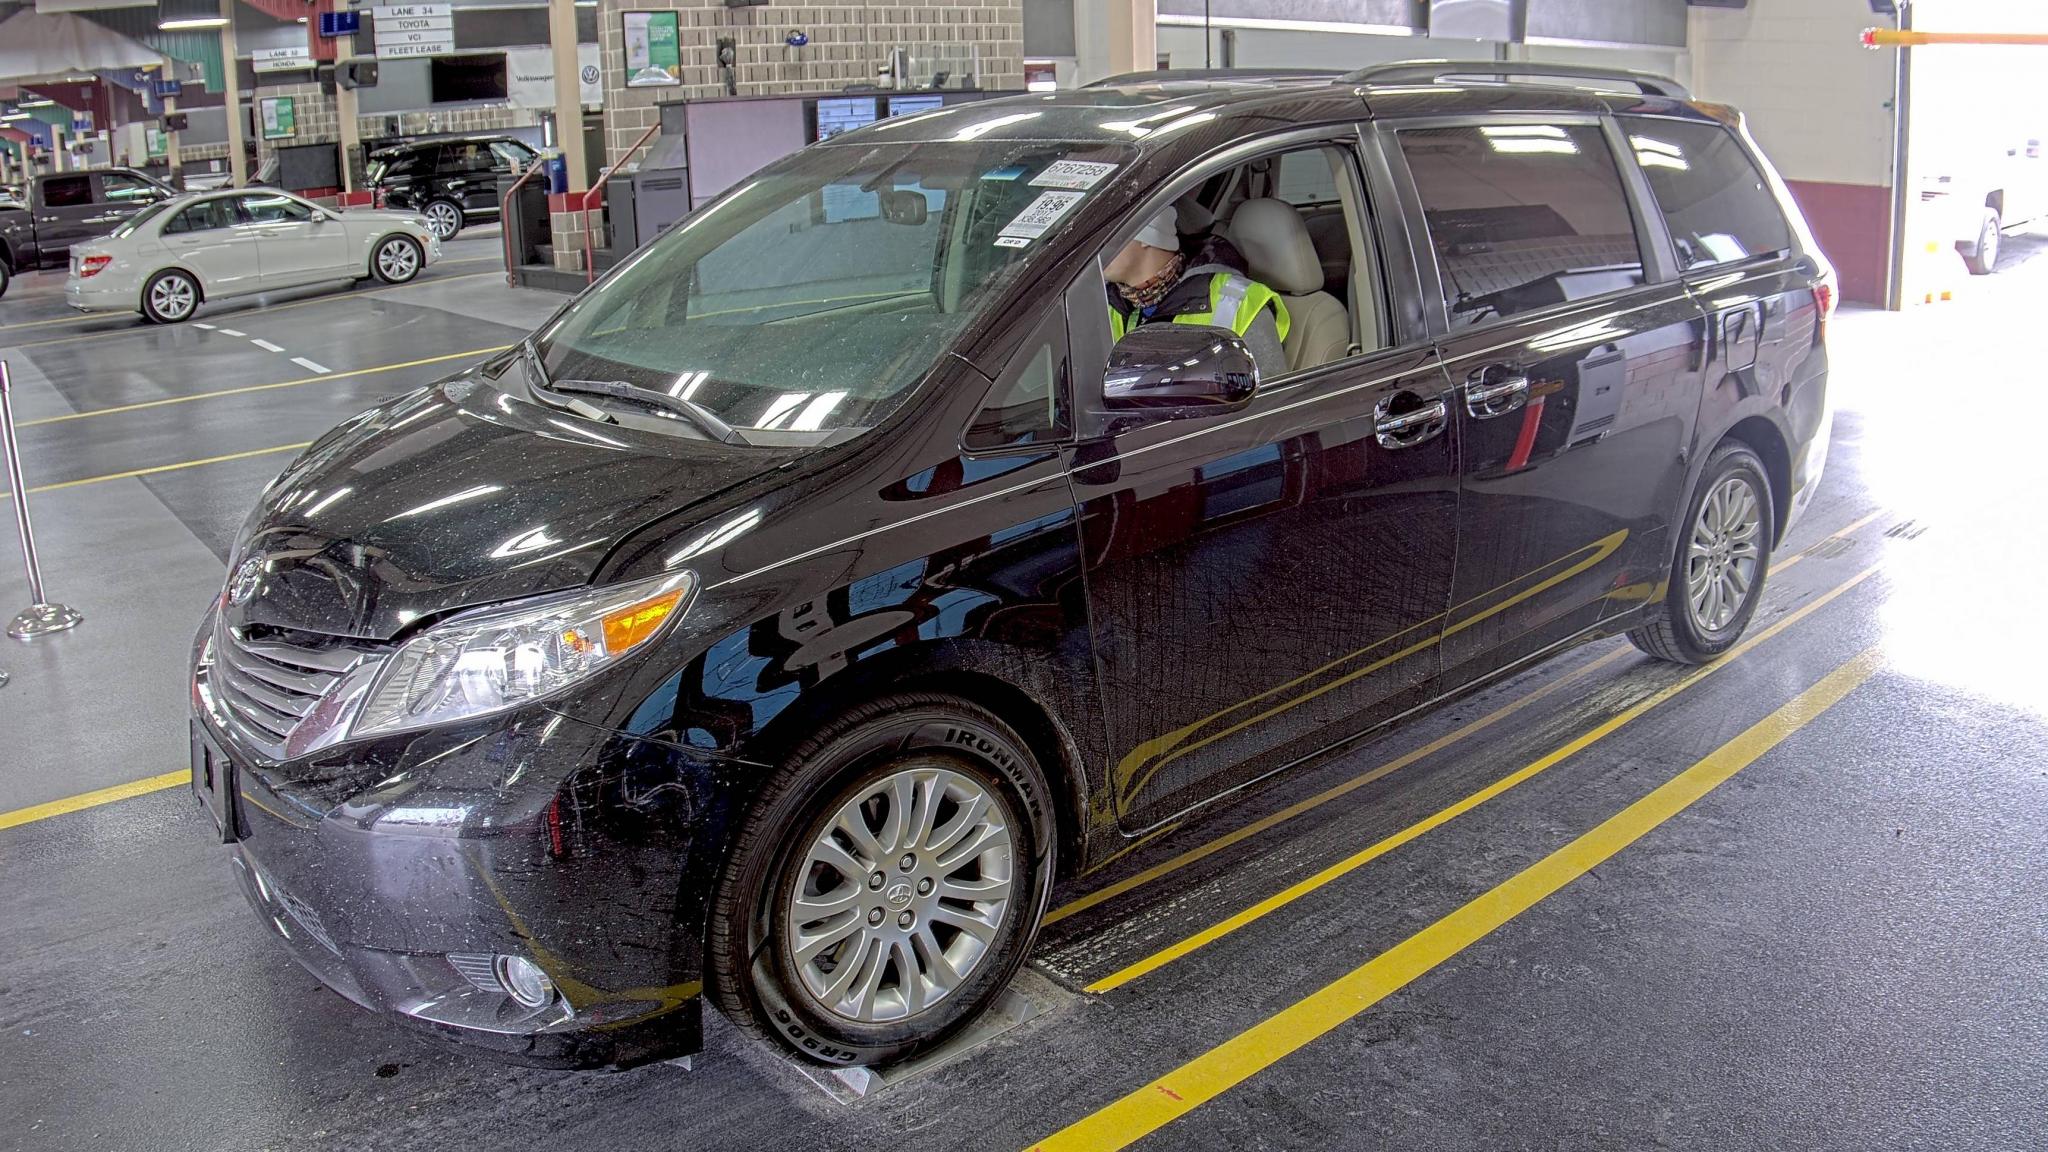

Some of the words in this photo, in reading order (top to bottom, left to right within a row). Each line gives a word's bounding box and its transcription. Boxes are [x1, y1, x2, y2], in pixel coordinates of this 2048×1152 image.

[391, 7, 415, 16] LANE
[422, 6, 433, 15] 34
[398, 20, 430, 29] TOYOTA
[407, 33, 421, 41] VCI
[389, 46, 414, 55] FLEET
[415, 44, 442, 53] LEASE
[1048, 162, 1108, 176] 6767258
[944, 728, 1042, 818] IRONMAN
[774, 1009, 858, 1062] GR906
